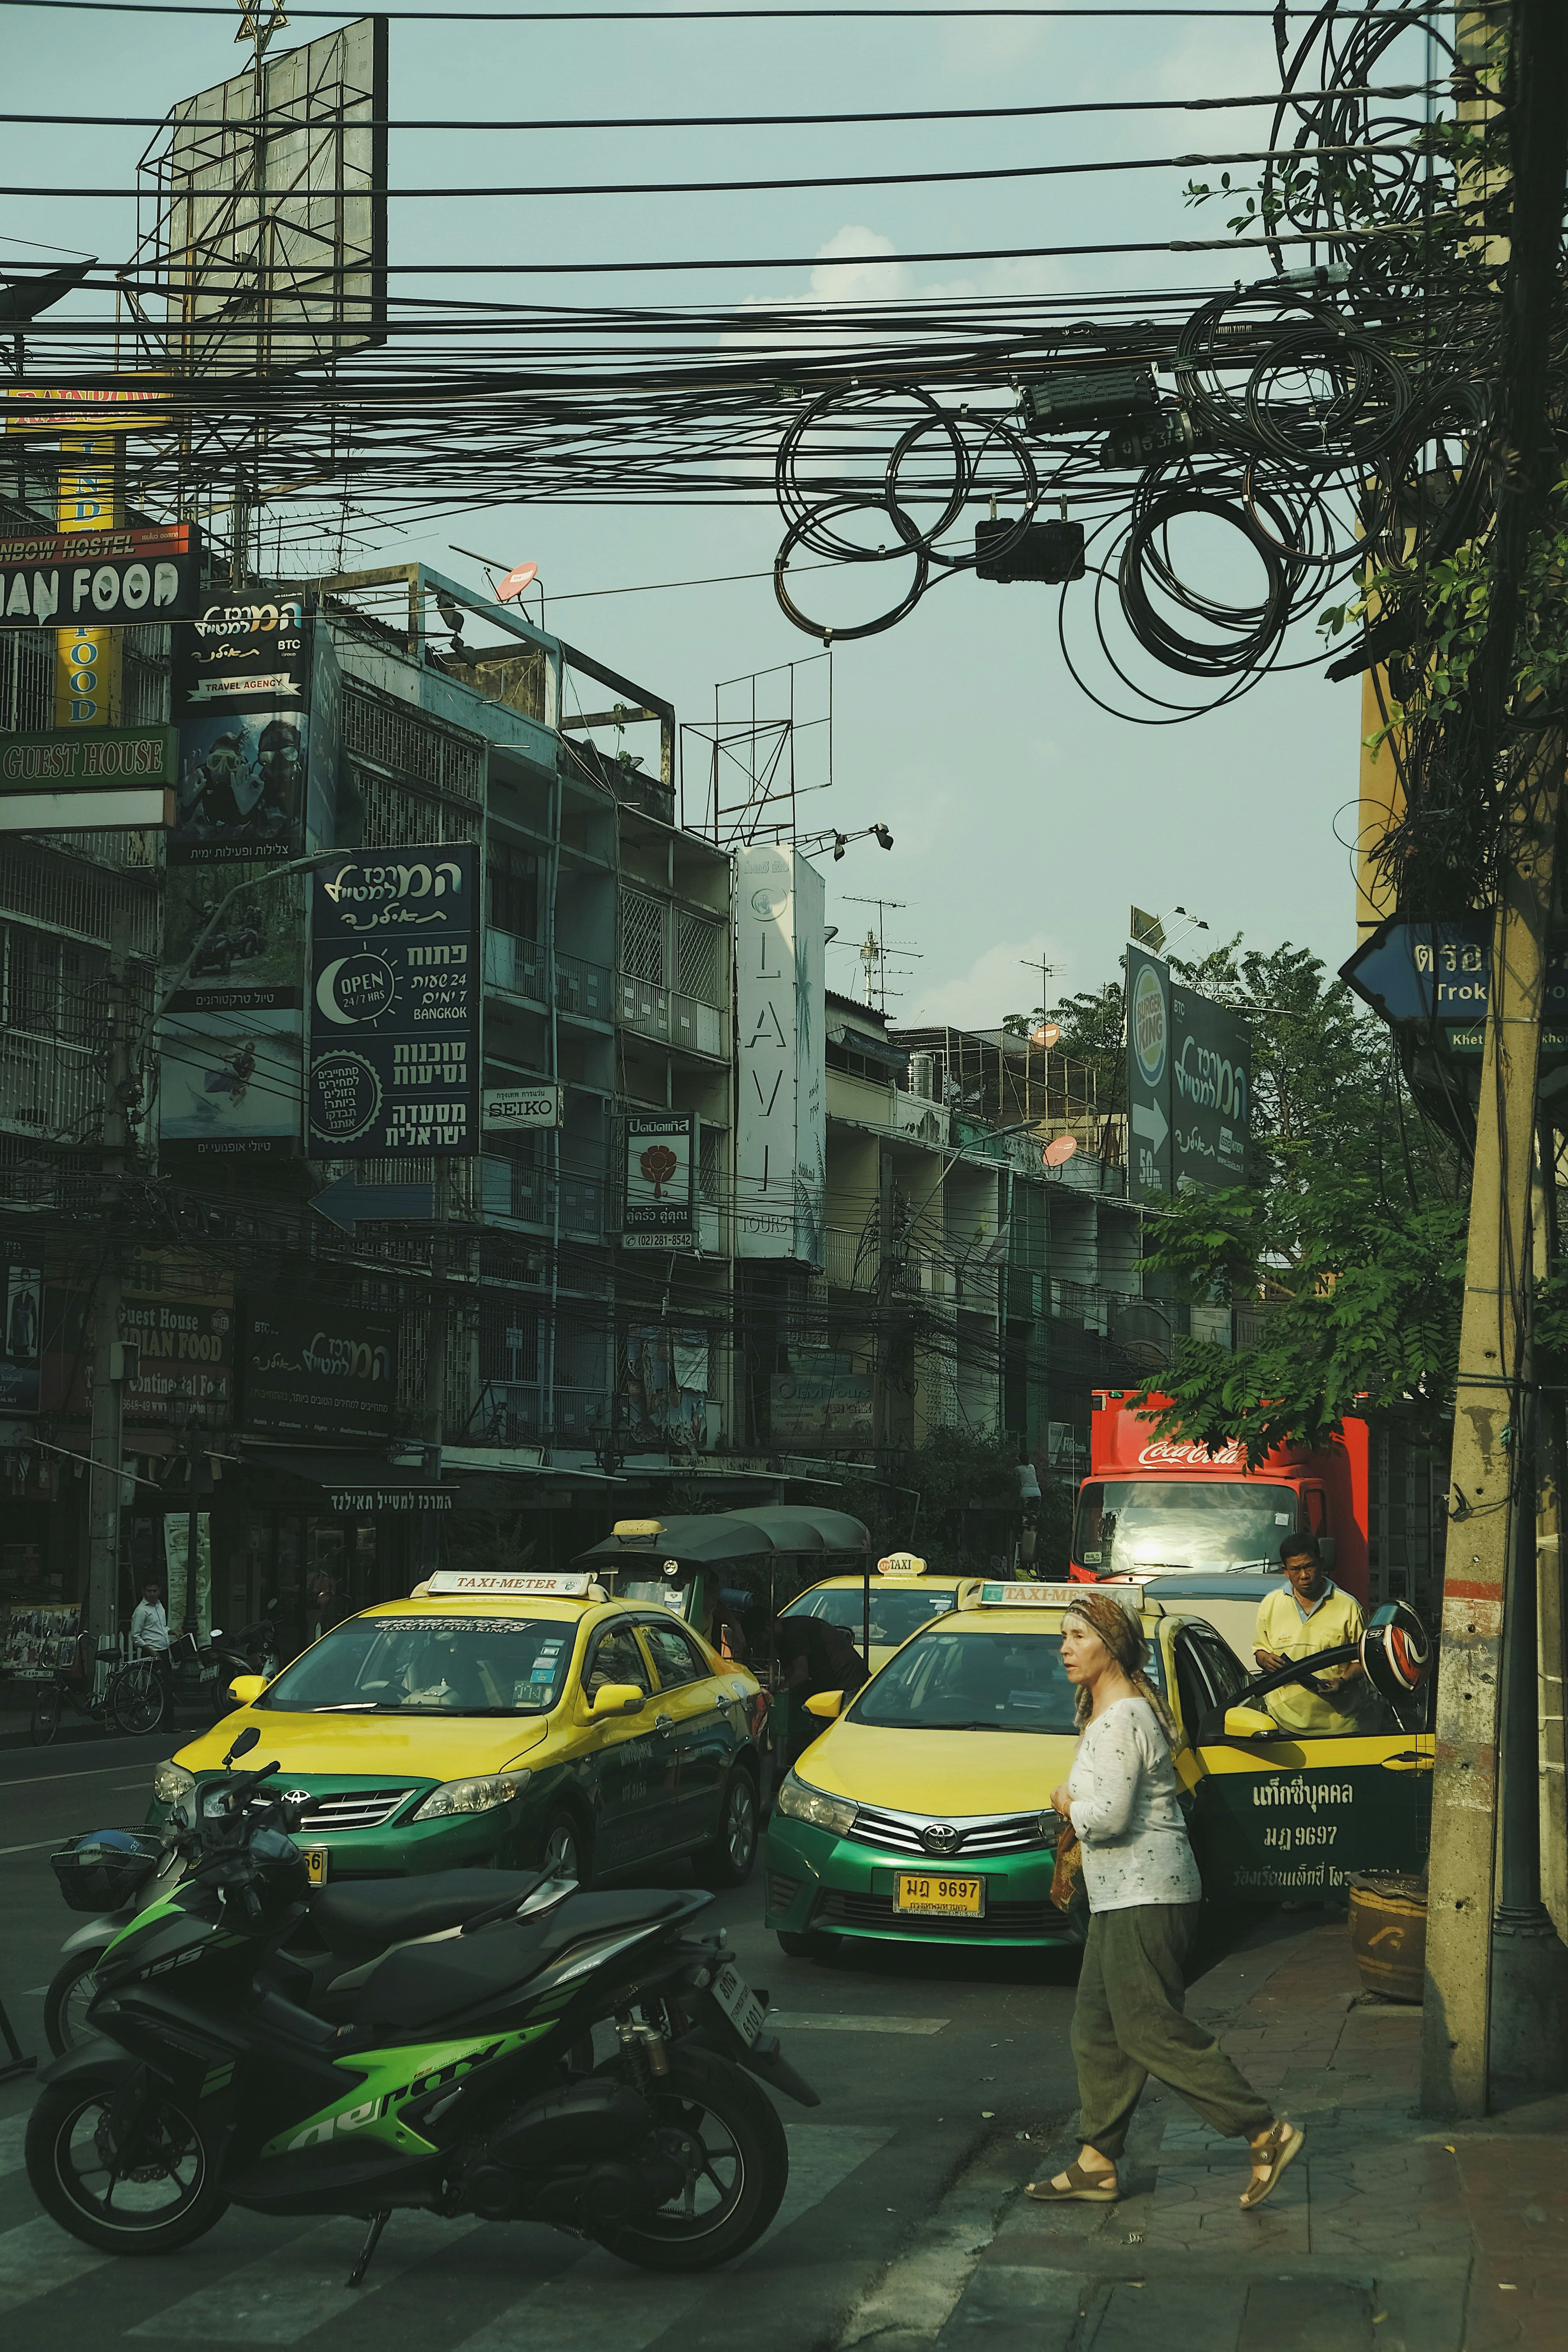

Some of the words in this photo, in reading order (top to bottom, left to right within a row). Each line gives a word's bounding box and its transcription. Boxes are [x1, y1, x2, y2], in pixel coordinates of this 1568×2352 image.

[62, 535, 136, 559] HOSTEL
[73, 562, 179, 612] FOOD
[278, 639, 301, 651] BTC
[206, 682, 241, 692] TRAVEL
[244, 679, 282, 689] AGENCY
[3, 742, 79, 779] GUEST
[82, 739, 163, 777] HOUSE
[190, 847, 212, 859] ימית
[214, 844, 253, 857] ופעילות
[256, 843, 289, 856] צלילות
[407, 945, 467, 966] פתוח
[341, 971, 384, 995] OPEN
[410, 974, 448, 988] שעות
[450, 973, 467, 985] 24
[254, 992, 274, 1004] טיול
[343, 994, 366, 1008] 24/7
[368, 990, 385, 1002] HRS
[421, 990, 455, 1005] ימים
[459, 990, 468, 1002] 7
[414, 1006, 467, 1020] BANGKOK
[1138, 993, 1161, 1024] BURGER
[1174, 999, 1185, 1016] BTC
[1137, 1012, 1163, 1055] KING
[1452, 1034, 1484, 1045] Khet
[393, 1042, 466, 1063] סוכנות
[318, 1067, 359, 1079] מתחייבים
[393, 1064, 467, 1085] נסיעות
[318, 1075, 359, 1089] למחירים
[324, 1087, 356, 1099] הזולים
[497, 1092, 519, 1101] กรุงเทพ
[522, 1089, 545, 1097] การแว่น
[324, 1098, 356, 1109] ביותר!
[489, 1100, 552, 1117] SEIKO
[325, 1109, 357, 1120] תבדקו
[392, 1104, 466, 1124] מסעדה
[328, 1119, 356, 1130] אותנו.
[385, 1122, 466, 1146] ישראלית
[198, 1143, 209, 1153] ים
[211, 1142, 250, 1153] אופנועי
[253, 1140, 271, 1152] טיולי
[740, 1216, 788, 1233] TOURS
[638, 1235, 653, 1246] (02)
[655, 1234, 691, 1246] 281-8542
[159, 1308, 198, 1331] House
[254, 1321, 270, 1334] BTC
[178, 1333, 222, 1362] FOOD
[310, 1394, 332, 1406] הטובים
[827, 1388, 871, 1398] Tours
[334, 1398, 359, 1410] למחירים
[360, 1401, 388, 1413] מתחייבים
[278, 1420, 301, 1429] Attractions
[313, 1424, 328, 1432] Flights
[331, 1491, 373, 1510] תאילנד
[377, 1491, 414, 1510] למטייל
[418, 1494, 452, 1510] המרכז
[890, 1559, 912, 1570] TAXI
[457, 1578, 557, 1590] TAXI-METER
[1252, 1775, 1353, 1813] แท็กซี่บุคคล
[1295, 1826, 1338, 1846] 9697
[939, 1881, 977, 1898] 9697
[140, 1945, 206, 1980] 155
[743, 2004, 762, 2039] 6101
